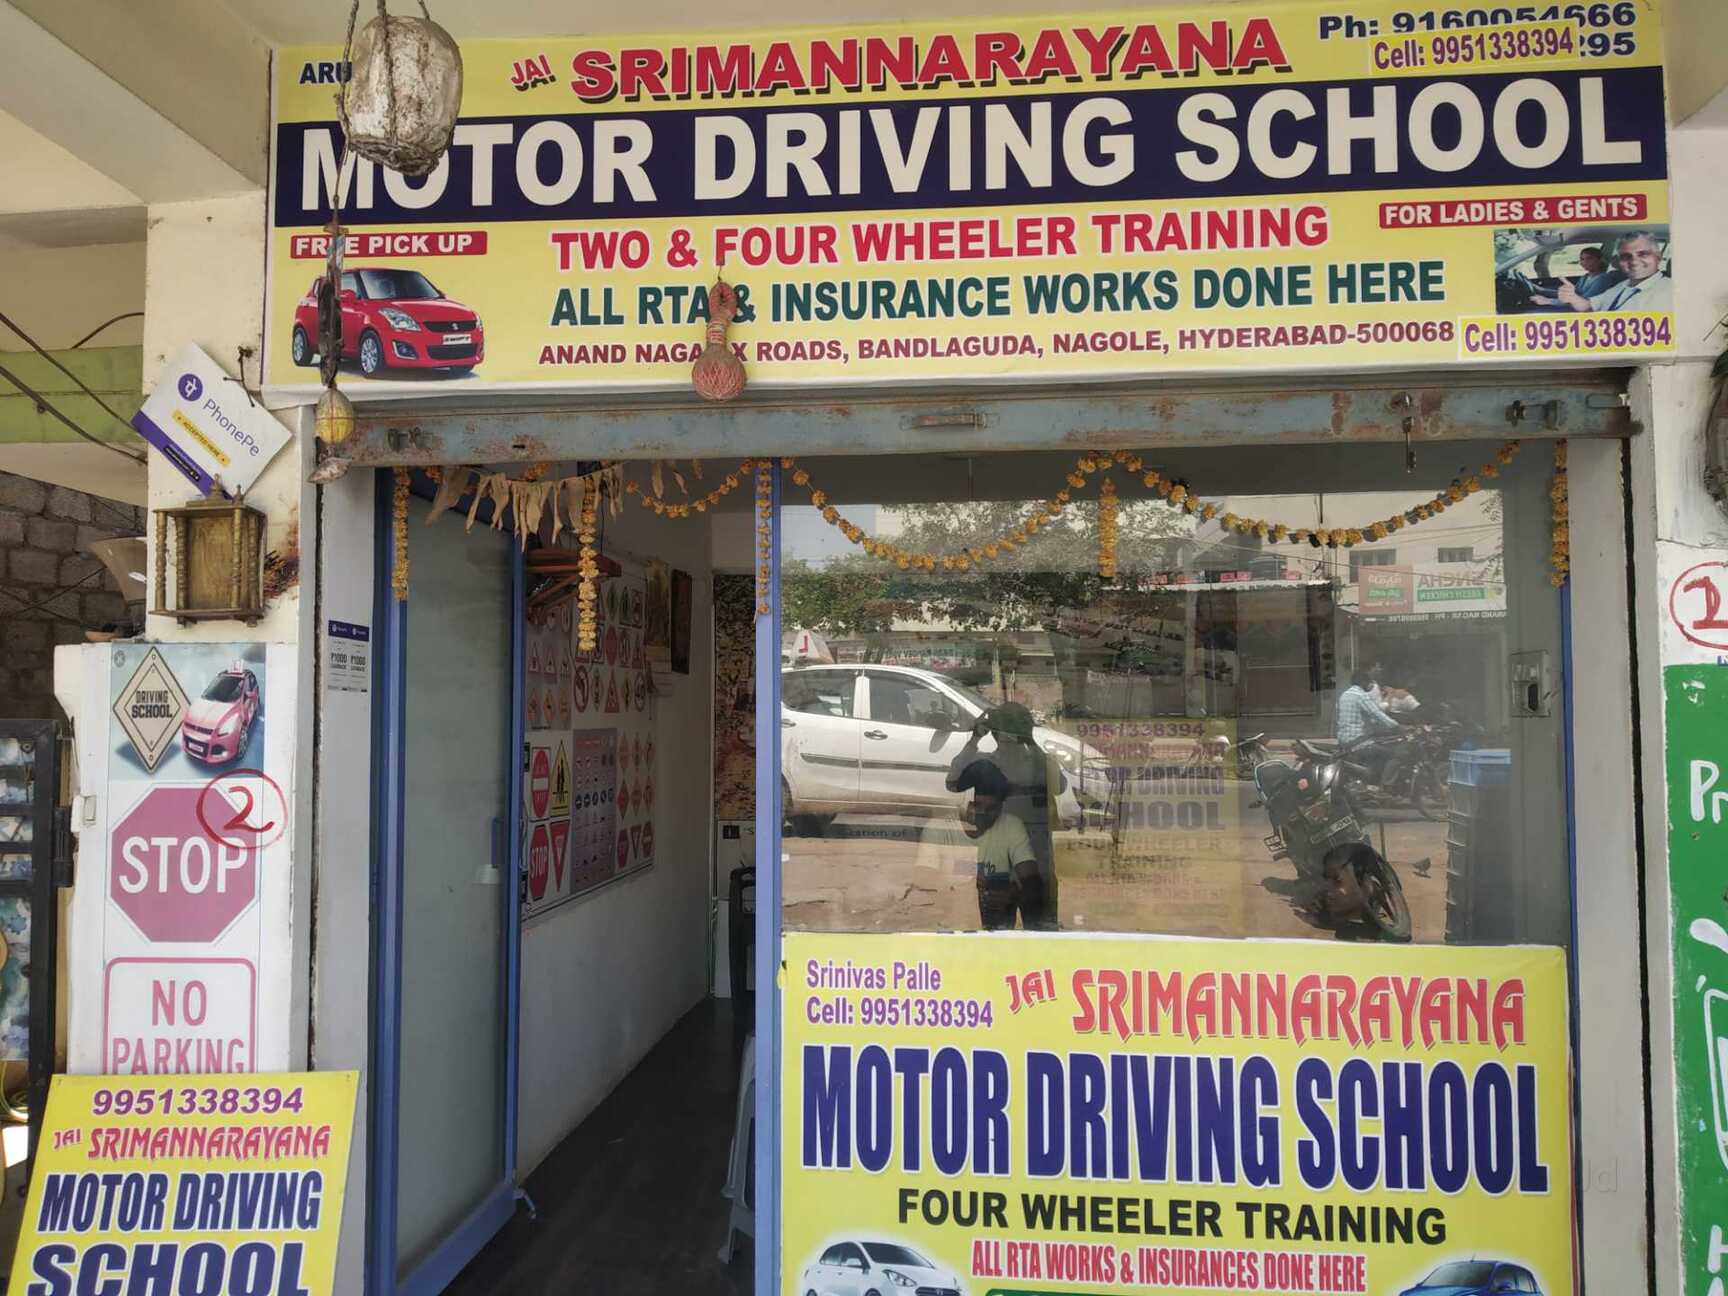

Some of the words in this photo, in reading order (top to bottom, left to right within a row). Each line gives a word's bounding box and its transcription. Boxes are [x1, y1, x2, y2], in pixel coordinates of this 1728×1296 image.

[1320, 16, 1378, 39] Ph:
[1374, 40, 1426, 70] Cell:
[1432, 26, 1575, 65] 9951338394
[510, 54, 556, 91] JAI
[571, 17, 1293, 103] SRIMANNARAYANA
[301, 118, 657, 211] MOTOR
[694, 97, 1135, 201] DRIVING
[1175, 76, 1643, 183] SCHOOL
[1385, 205, 1432, 225] FOR
[1440, 201, 1524, 224] LADIES
[1533, 201, 1550, 219] &
[1558, 197, 1638, 220] GENTS
[296, 237, 360, 256] FRE
[369, 235, 430, 254] PICK
[438, 234, 473, 252] UP
[552, 232, 650, 271] TWO
[667, 229, 698, 268] &
[716, 226, 838, 267] FOUR
[852, 216, 1076, 262] WHEELER
[1093, 206, 1329, 254] TRAINING
[551, 288, 624, 326] ALL
[638, 286, 711, 325] RTA
[732, 284, 757, 323] &
[771, 277, 1010, 323] INSURANCE
[1023, 271, 1179, 315] WORKS
[1194, 265, 1312, 309] DONE
[1328, 261, 1446, 305] HERE
[539, 345, 626, 365] ANAND
[757, 340, 849, 364] ROADS,
[858, 335, 1044, 361] BANDLAGUDA,
[1052, 331, 1169, 356] NAGOLE,
[1178, 321, 1455, 351] HYDERABAD-500068
[1465, 322, 1517, 353] Cell:
[1525, 316, 1671, 351] 9951338394
[203, 398, 260, 457] PhonePe
[131, 705, 172, 719] SCHOOL
[136, 690, 169, 703] DRIVING
[224, 786, 275, 832] 2
[119, 836, 248, 894] STOP
[807, 960, 886, 990] Srinivas
[892, 962, 942, 991] Palle
[152, 979, 208, 1026] NO
[807, 997, 855, 1024] Cell:
[860, 999, 993, 1028] 9951338394
[1005, 969, 1057, 1013] JAI
[1071, 969, 1526, 1050] SRIMANNARAYANA
[112, 1037, 244, 1075] PARKING
[93, 1087, 303, 1116] 9951338394
[803, 1044, 1010, 1175] MOTOR
[1026, 1051, 1281, 1187] DRIVING
[1295, 1057, 1548, 1194] SCHOOL
[53, 1129, 81, 1150] JAI
[87, 1125, 331, 1160] SRIMANNARAYANA
[37, 1173, 168, 1232] MOTOR
[173, 1170, 323, 1230] DRIVING
[899, 1187, 1009, 1229] FOUR
[1021, 1192, 1224, 1238] WHEELER
[1236, 1201, 1447, 1245] TRAINING
[26, 1241, 310, 1296] SCHOOL
[973, 1239, 1003, 1277] ALL
[1007, 1241, 1042, 1280] RTA
[1045, 1243, 1116, 1284] WORKS
[1120, 1255, 1134, 1285] &
[1138, 1247, 1260, 1290] INSURANCES
[1263, 1252, 1313, 1292] DONE
[1318, 1254, 1366, 1293] HERE
